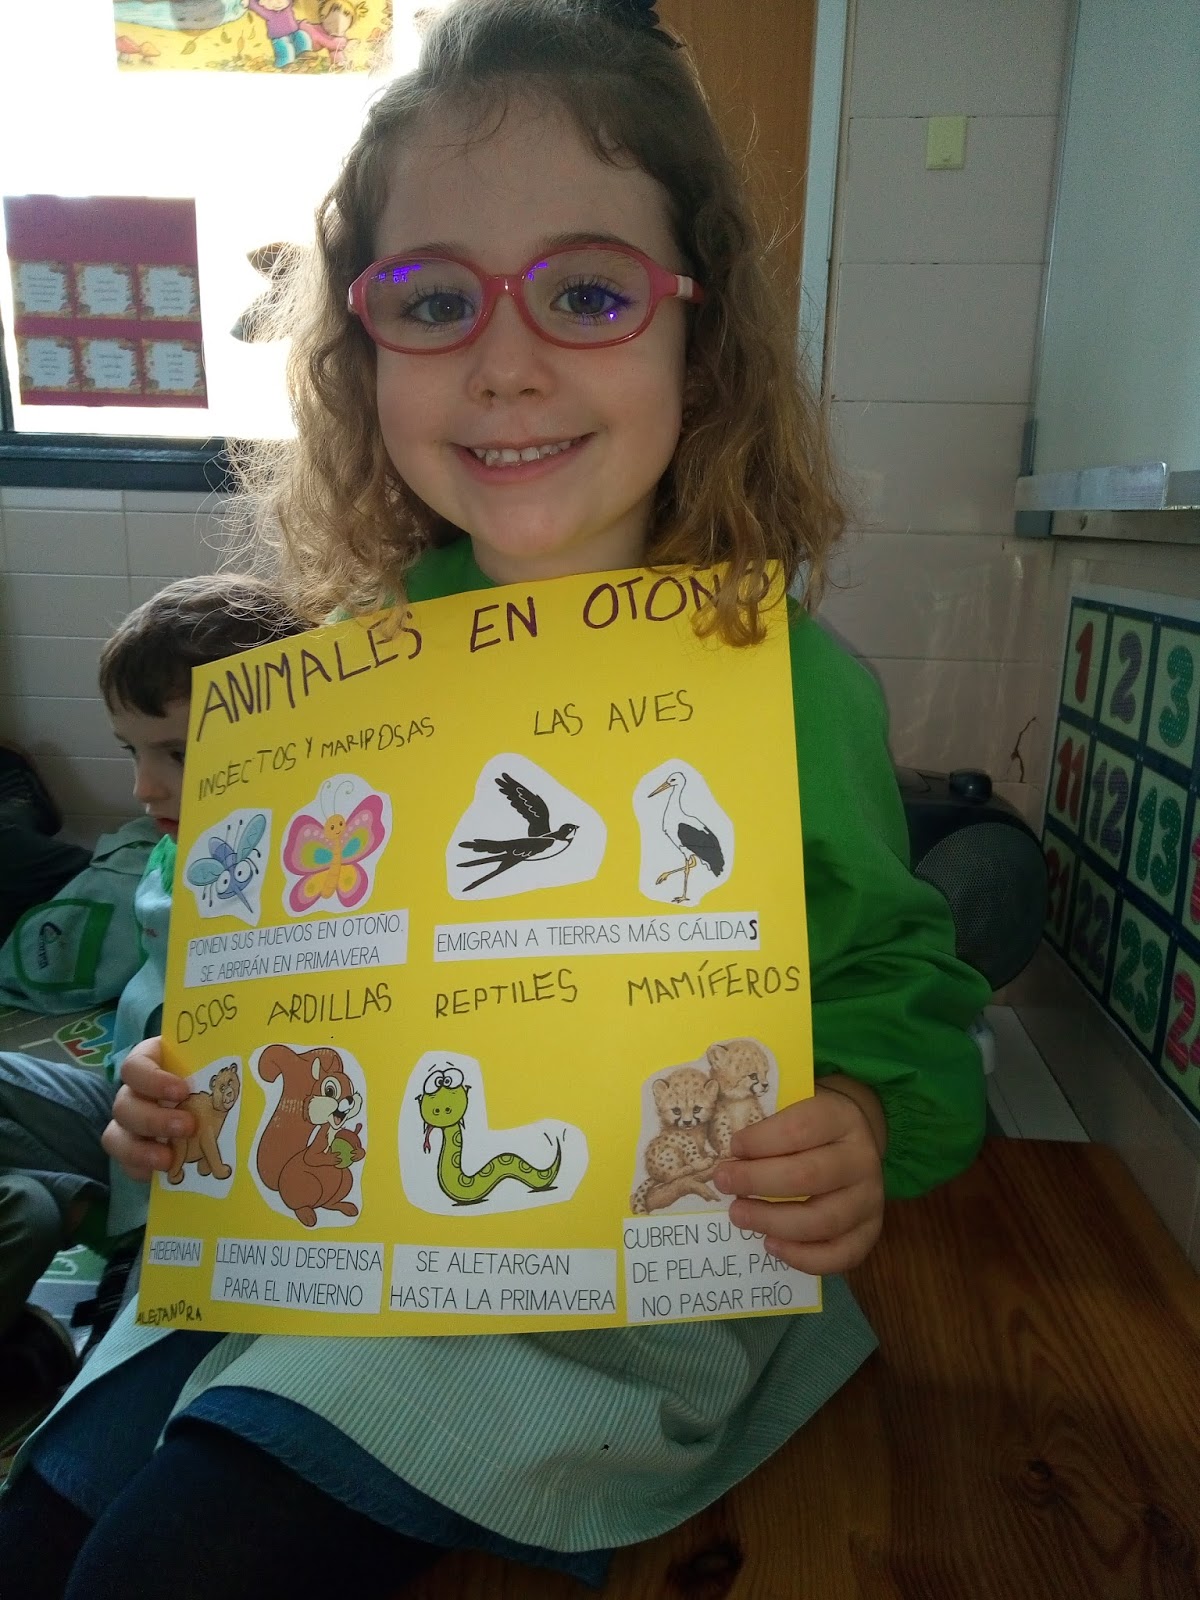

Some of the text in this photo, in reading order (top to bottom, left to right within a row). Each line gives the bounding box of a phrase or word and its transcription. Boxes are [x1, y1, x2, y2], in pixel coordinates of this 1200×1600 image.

[196, 610, 422, 742] ANIMALES
[469, 596, 538, 653] EN
[1075, 621, 1194, 748] 1 2 3
[533, 689, 694, 737] LAS AVES
[198, 716, 435, 801] INSECTOS Y MARIPOSAS
[1056, 736, 1086, 826] 11
[1089, 758, 1130, 857] 12
[1137, 786, 1182, 896] 13
[188, 939, 229, 958] PONEN
[231, 931, 255, 952] SUS
[258, 923, 313, 946] HUEVOS
[317, 920, 338, 940] EN
[437, 917, 759, 953] EMIGRAN A TIERRAS MÁS CÁLIDAS
[200, 945, 381, 984] SE ABRIRÁN EN PRIMAVERA
[627, 959, 801, 1007] MAMÍFEROS
[1113, 918, 1163, 1034] 23
[266, 982, 393, 1026] ARDILLAS
[435, 967, 578, 1018] REPTILES
[176, 994, 238, 1044] OSOS
[150, 1240, 201, 1262] HIBERNAN
[623, 1223, 699, 1250] CUBREN
[706, 1221, 732, 1243] SU
[215, 1242, 383, 1272] LLENAN SU DESPENSA
[416, 1250, 570, 1276] SE ALETARGAN
[632, 1252, 790, 1284] DE PELAJE, PAR
[223, 1276, 364, 1307] PARA EL INVIERNO
[390, 1284, 616, 1311] HASTA LA PRIMAVERA
[642, 1280, 793, 1318] NO PASAR FRÍO
[135, 1299, 203, 1326] ALEJANDRA
